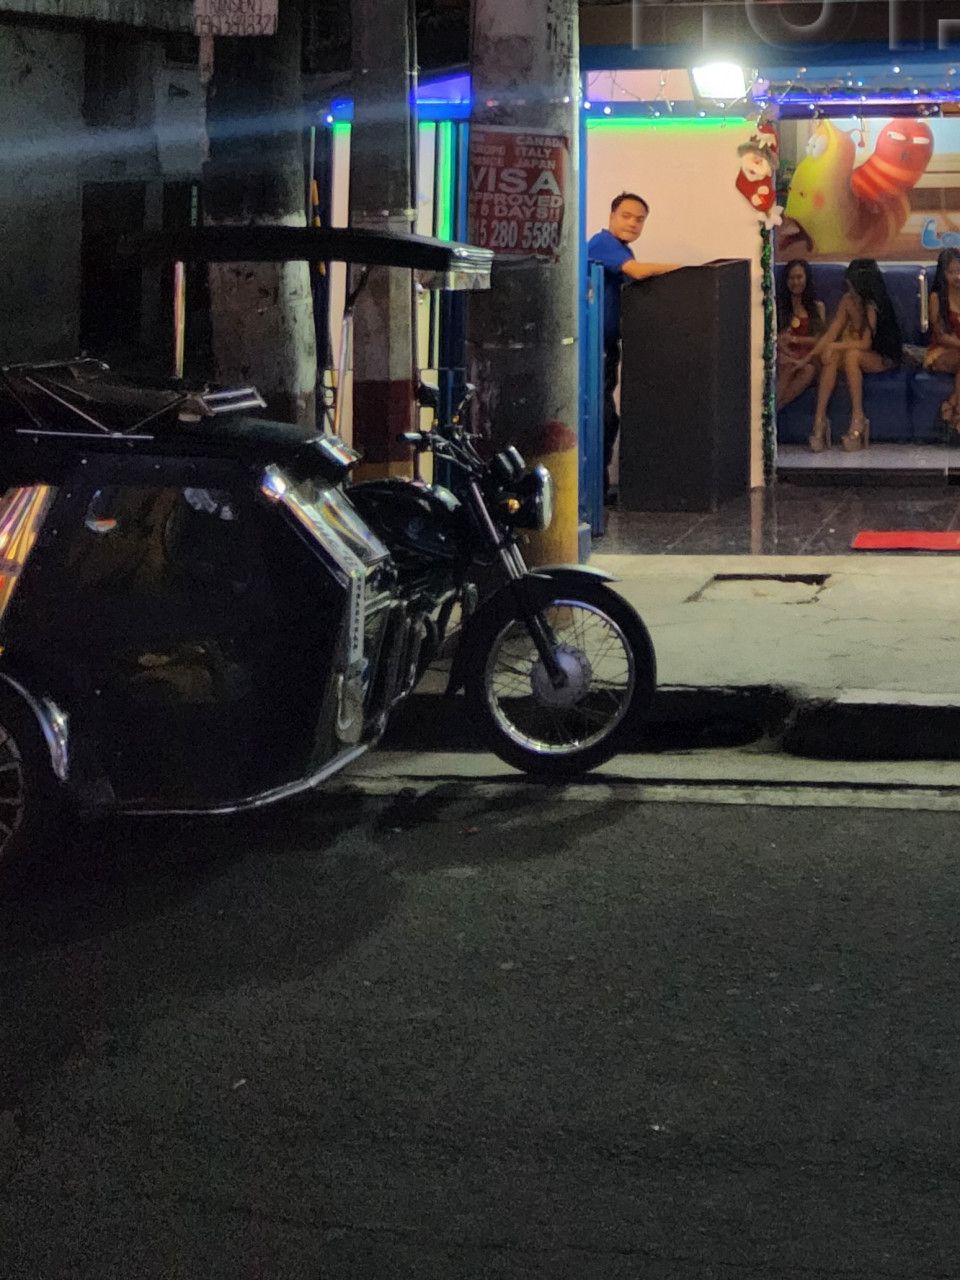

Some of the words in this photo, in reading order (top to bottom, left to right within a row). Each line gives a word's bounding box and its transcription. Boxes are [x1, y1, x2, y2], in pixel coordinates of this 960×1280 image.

[515, 147, 553, 159] ITALY
[513, 159, 557, 170] JAPAN
[470, 166, 562, 195] VISA
[470, 191, 563, 208] PPROVED
